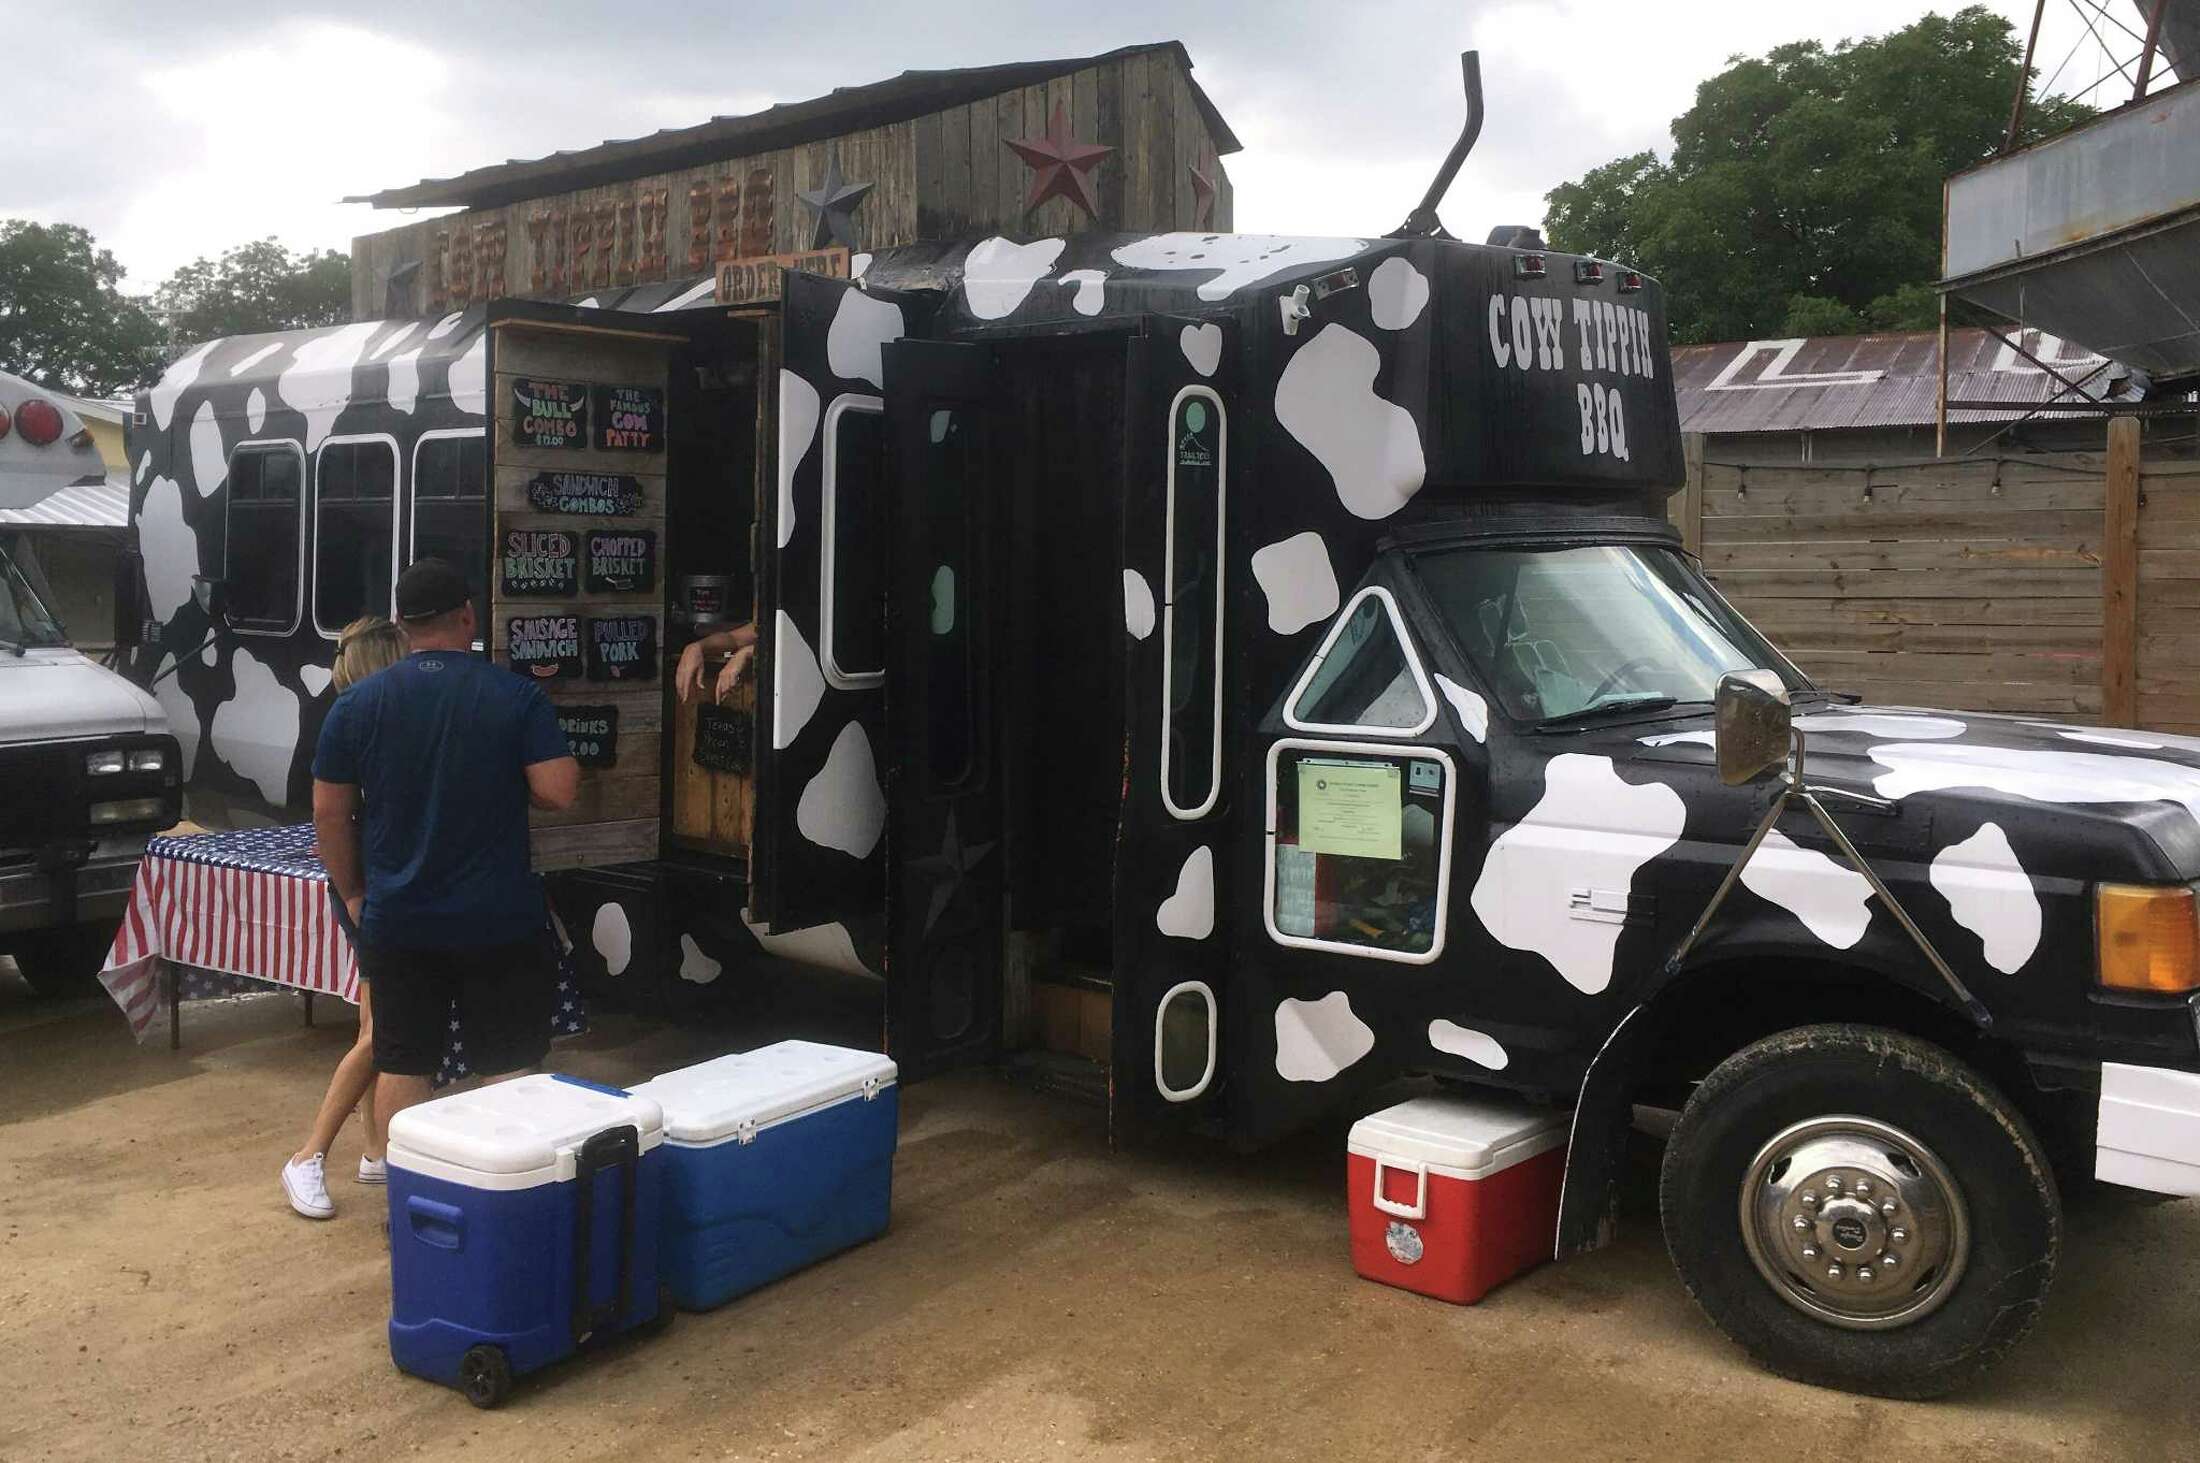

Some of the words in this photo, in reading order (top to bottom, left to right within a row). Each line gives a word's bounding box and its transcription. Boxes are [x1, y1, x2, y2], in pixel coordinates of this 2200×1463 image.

[1489, 294, 1563, 370] COW
[1573, 298, 1653, 379] TIPPIN
[532, 399, 572, 418] BULL
[523, 416, 577, 437] COMBO
[1577, 382, 1629, 462] BBQ
[606, 428, 650, 447] PATTY
[553, 474, 619, 498] SANDWICH
[559, 498, 615, 514] COMBOS
[507, 531, 571, 558] SLICED
[590, 536, 646, 558] CHOPPED
[504, 557, 576, 579] BRISKET
[592, 558, 645, 576] BRISKET
[510, 618, 578, 640] SAUSAGE
[594, 621, 648, 642] PULLED
[510, 639, 578, 661] SANDWICH
[599, 642, 640, 662] PORK
